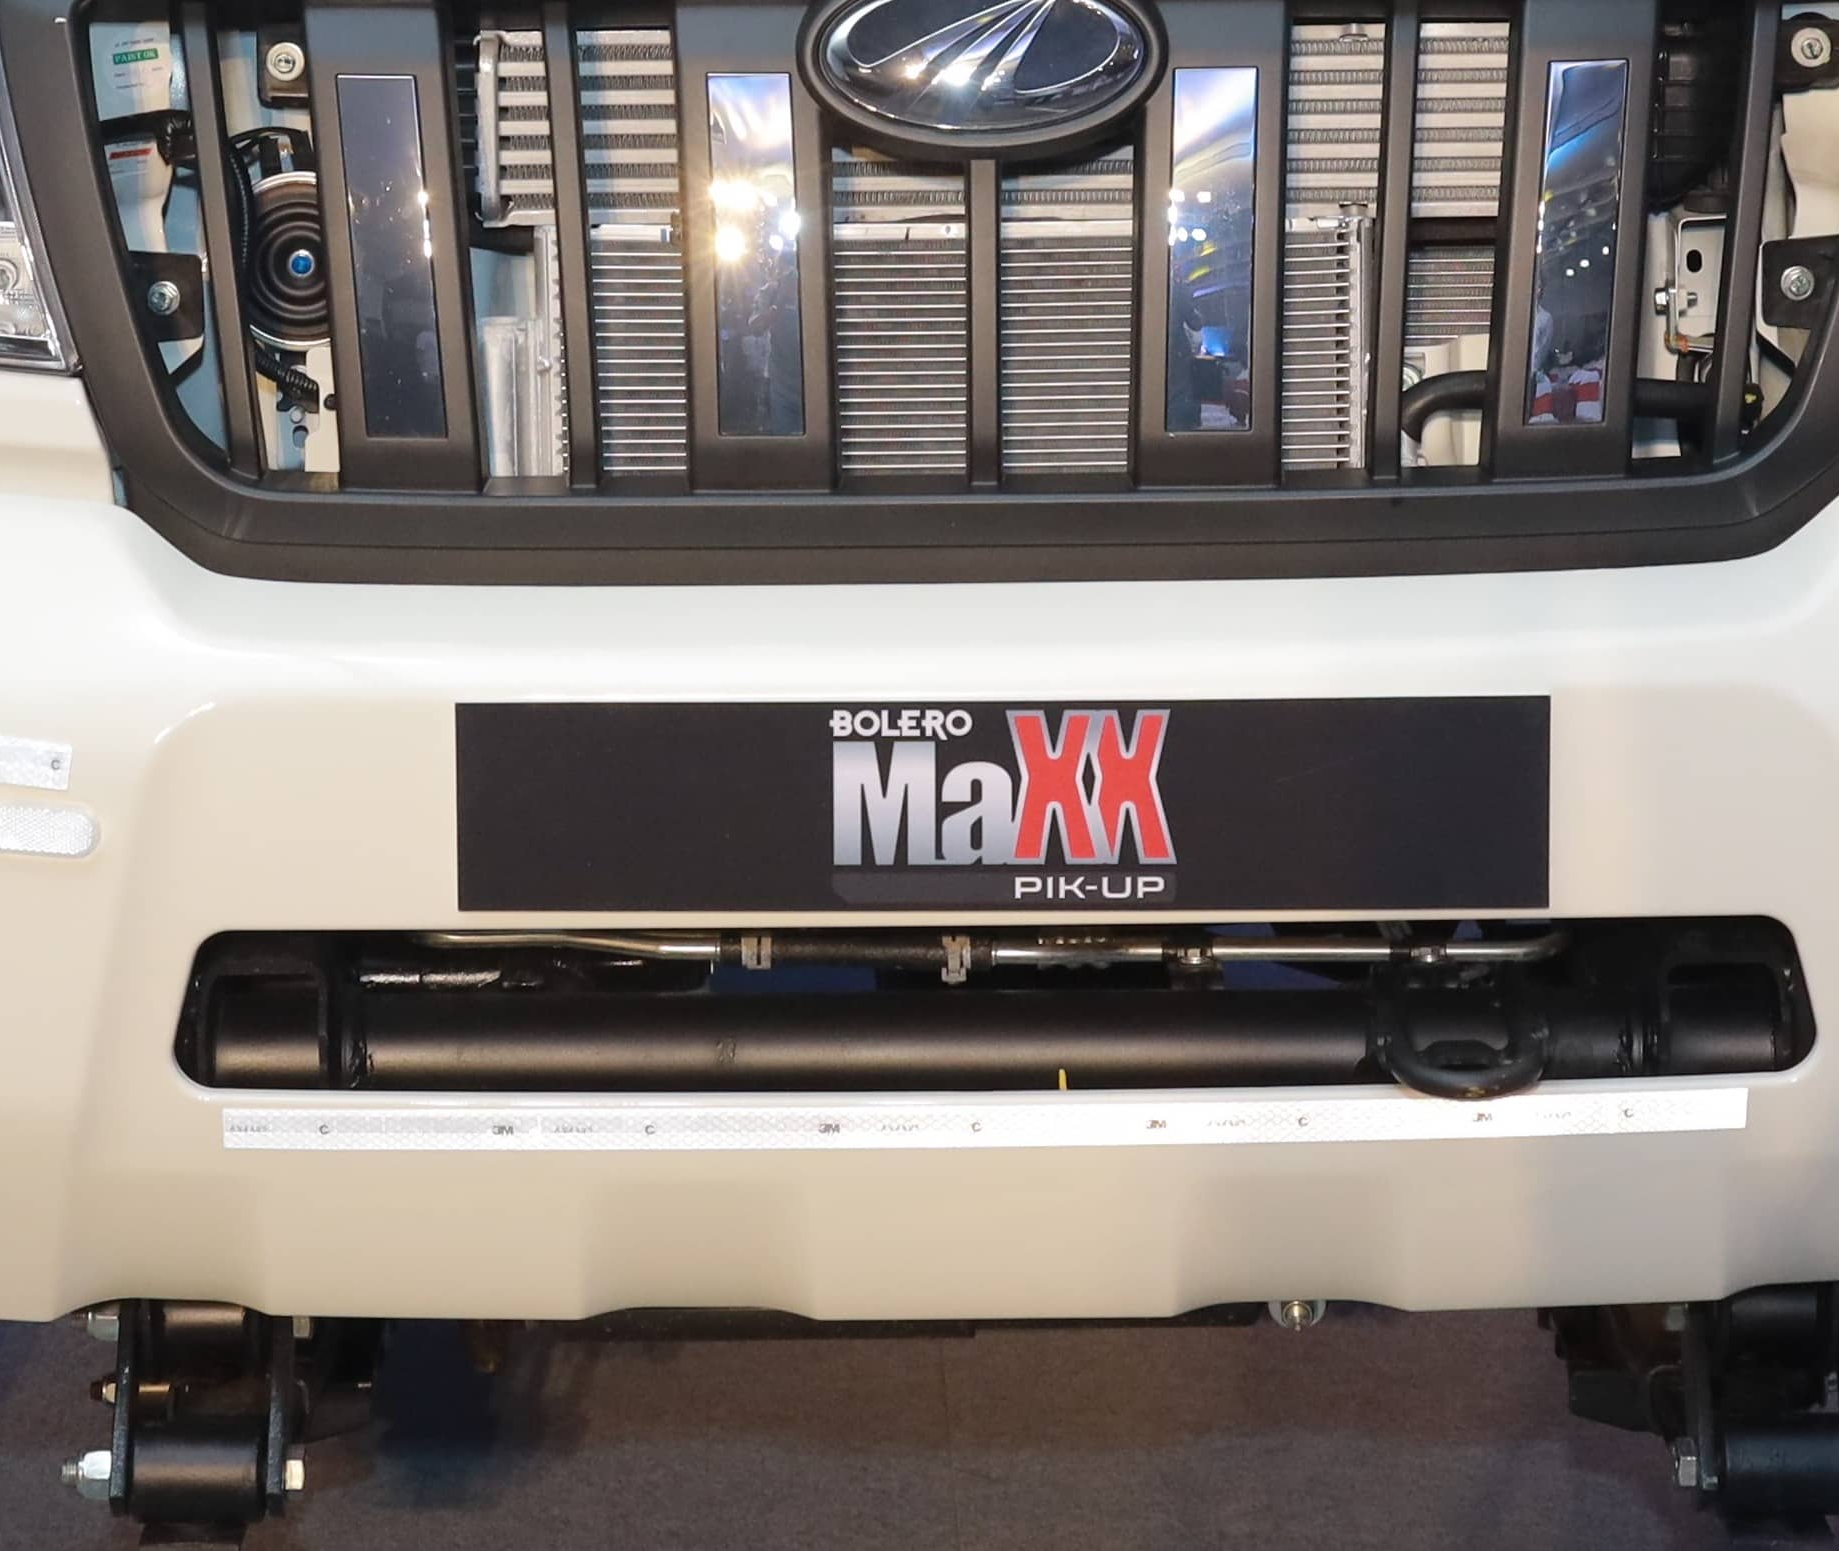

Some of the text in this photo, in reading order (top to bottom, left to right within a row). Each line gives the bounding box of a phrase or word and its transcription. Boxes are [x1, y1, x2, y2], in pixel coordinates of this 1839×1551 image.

[829, 709, 973, 741] BOLERO
[50, 759, 61, 771] C
[832, 708, 1178, 866] MaXX
[1013, 875, 1166, 900] PIK-UP
[492, 1125, 514, 1135] 3M
[818, 1123, 841, 1134] 3M
